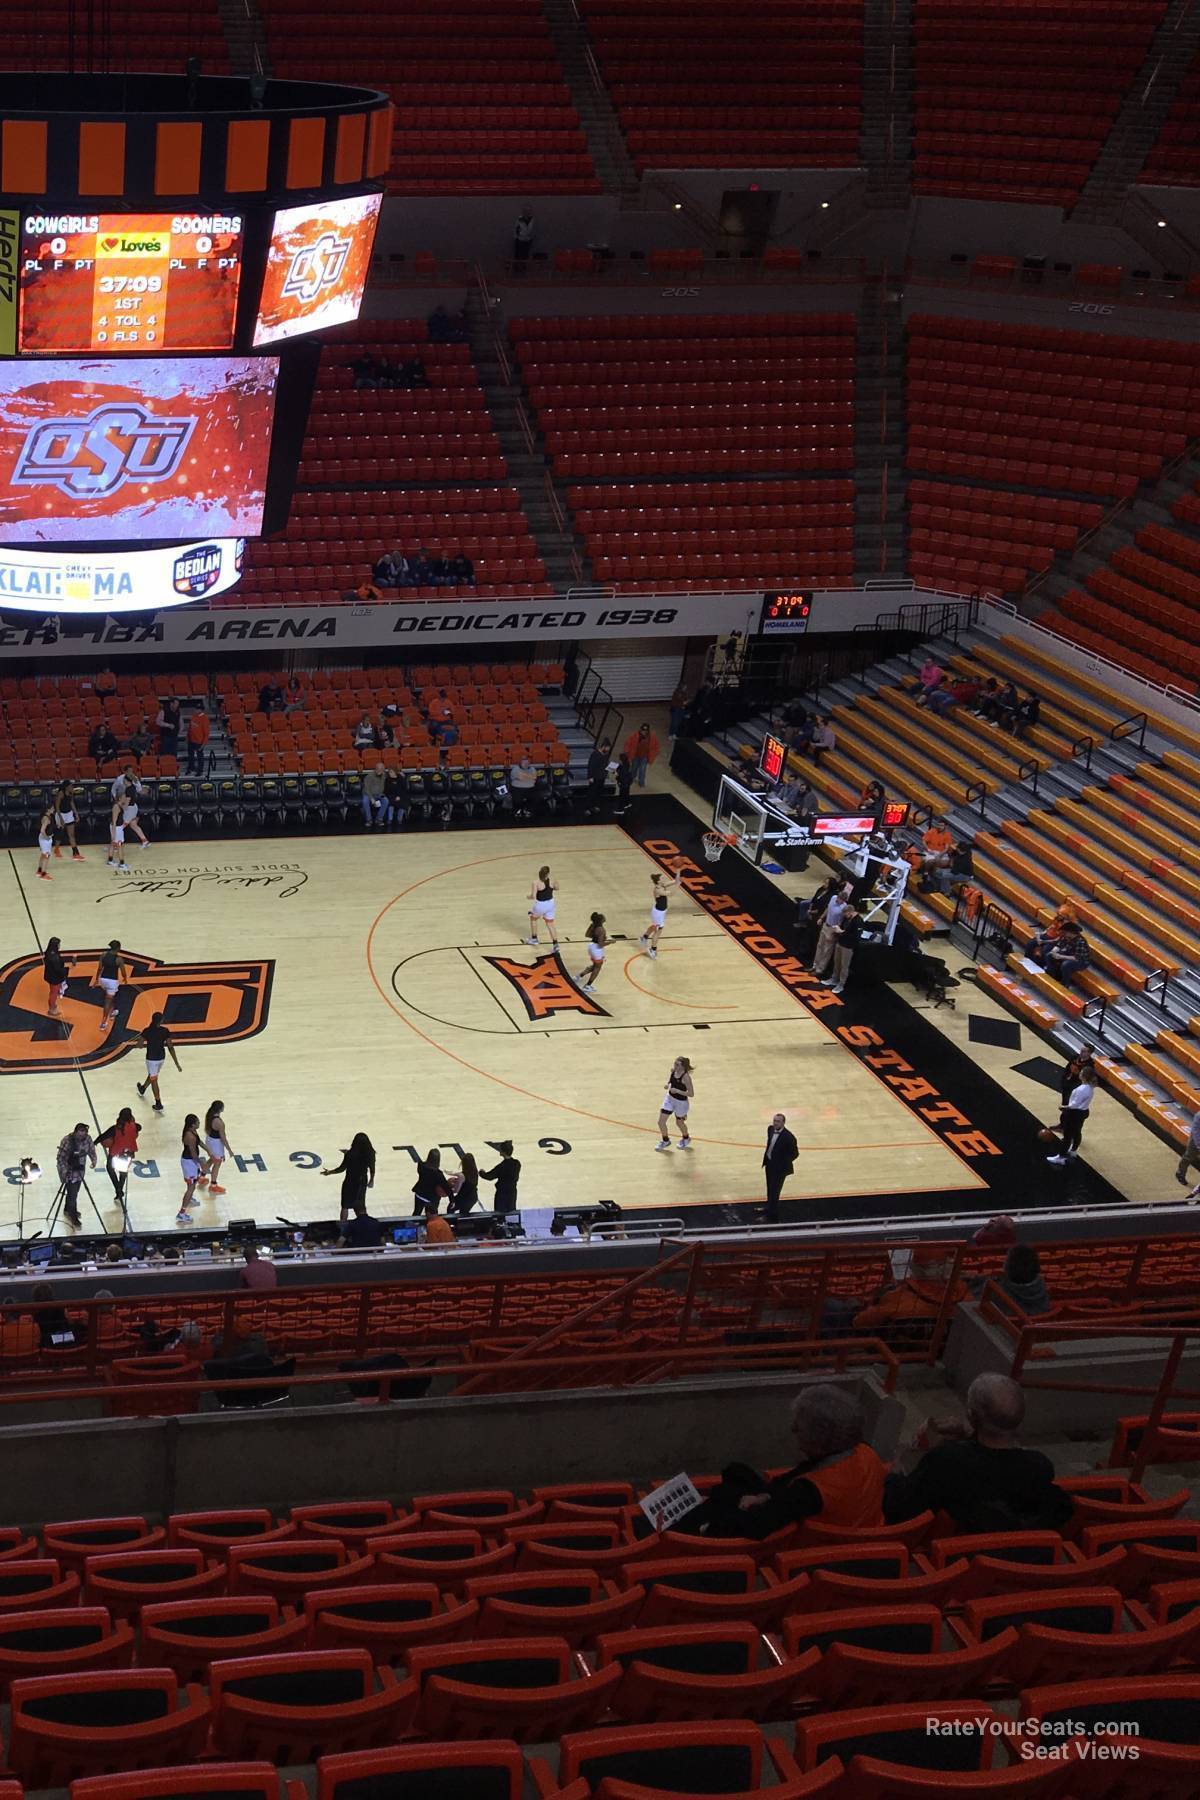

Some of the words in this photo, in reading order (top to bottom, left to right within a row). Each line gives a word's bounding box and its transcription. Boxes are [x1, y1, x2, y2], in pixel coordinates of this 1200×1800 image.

[25, 216, 99, 234] COWGIRLS
[171, 216, 242, 234] SOONERS
[50, 237, 67, 254] 0
[195, 236, 212, 254] 0
[25, 260, 43, 271] PL
[54, 260, 64, 271] F
[74, 259, 94, 271] PT
[170, 259, 187, 270] PL
[198, 259, 208, 269] F
[218, 258, 238, 269] PT
[99, 276, 163, 293] 37:09
[661, 287, 701, 298] 205
[114, 298, 143, 310] 1ST
[1068, 302, 1115, 315] 206
[97, 316, 108, 327] 4
[115, 315, 142, 327] TOL
[146, 315, 156, 326] 4
[97, 331, 108, 342] 0
[113, 331, 138, 342] FLS
[146, 330, 156, 341] 0
[9, 402, 199, 500] OSU
[175, 551, 221, 580] BEDLAM
[393, 611, 593, 633] DEDICATED
[596, 608, 679, 626] 1938
[186, 617, 337, 642] ARENA
[177, 865, 243, 873] SUTTON
[836, 1024, 1004, 1157] STATE
